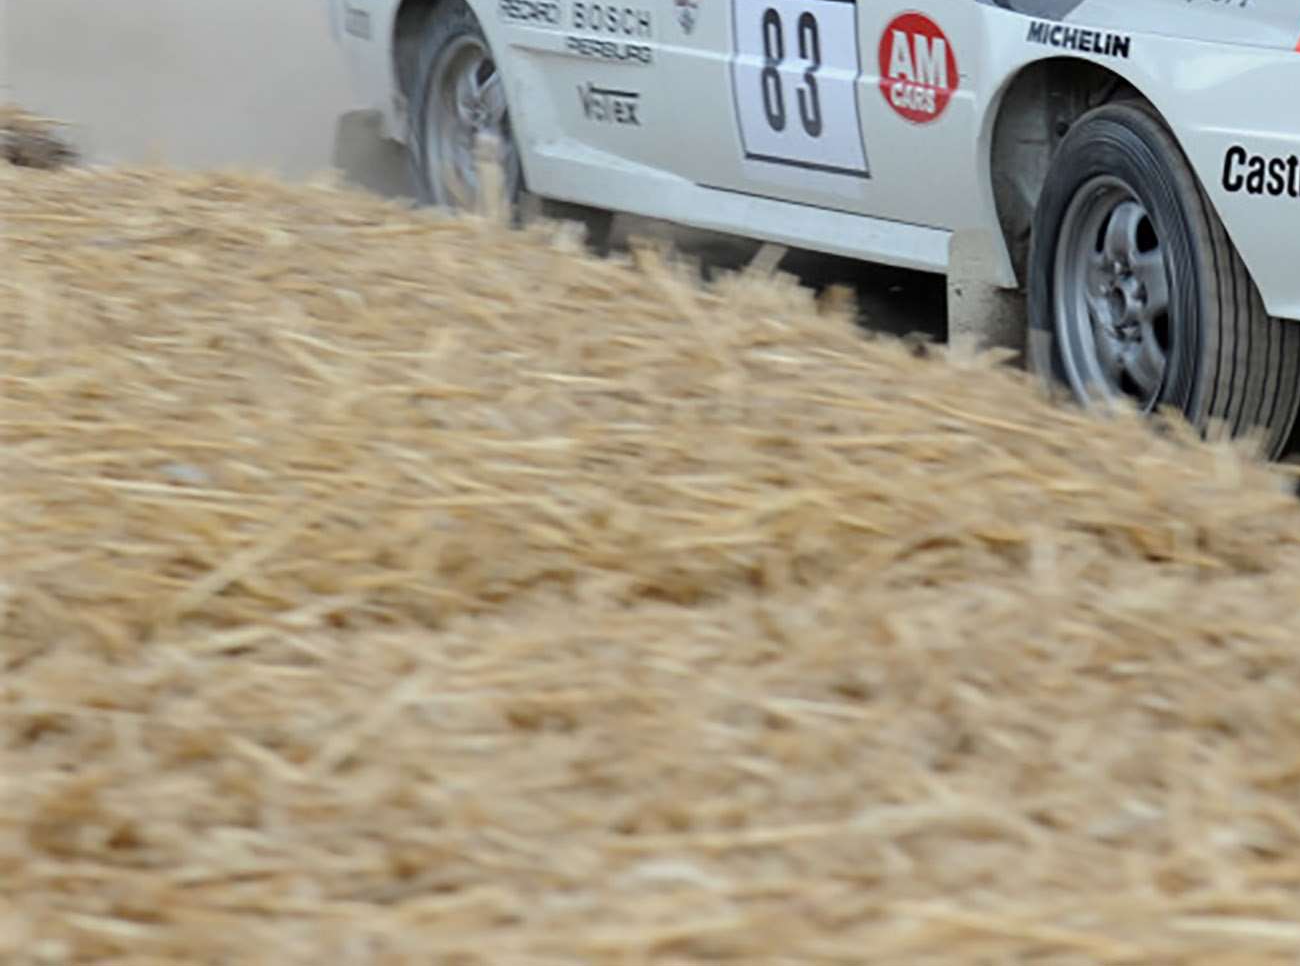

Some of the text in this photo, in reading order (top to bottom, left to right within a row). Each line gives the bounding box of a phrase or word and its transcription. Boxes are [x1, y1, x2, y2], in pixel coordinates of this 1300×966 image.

[573, 1, 652, 36] BOSCH
[566, 35, 653, 64] PIERBURG
[1026, 20, 1132, 59] MICHELIN
[761, 8, 822, 138] 83
[889, 30, 947, 89] AM
[890, 82, 936, 114] CARS
